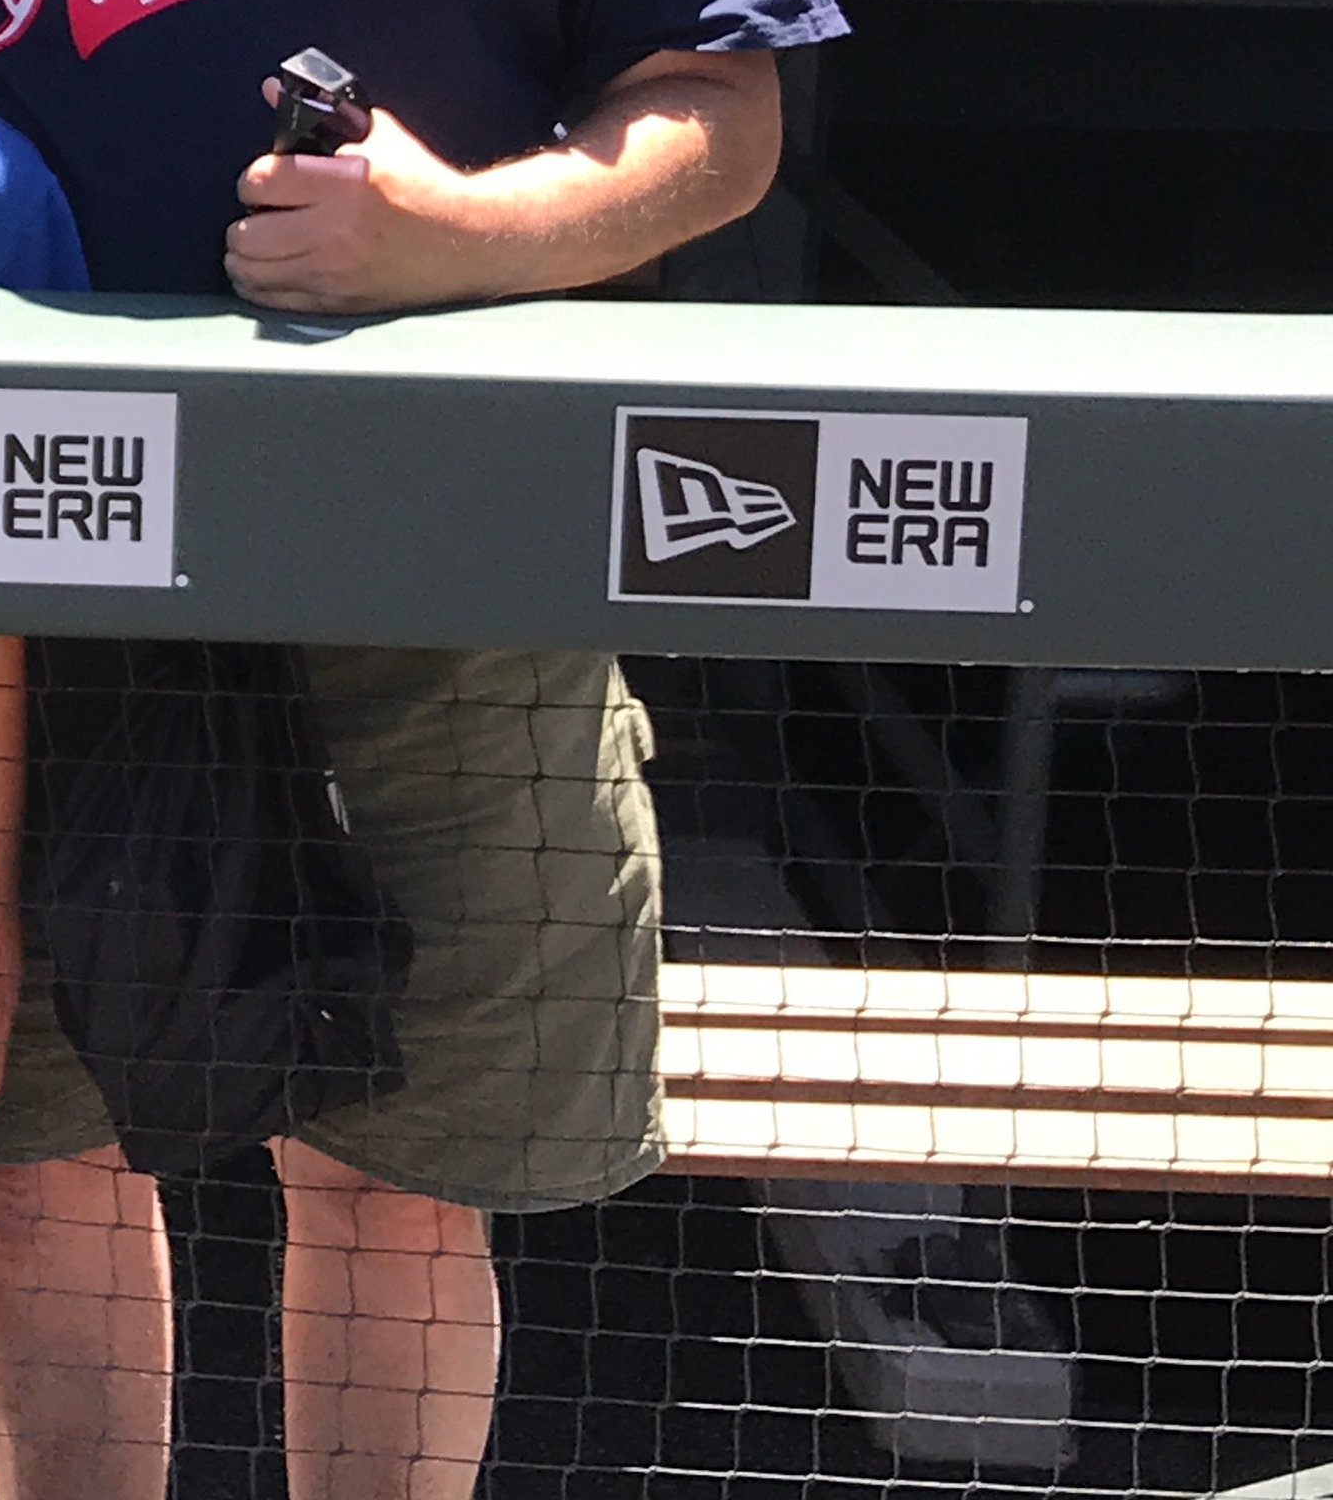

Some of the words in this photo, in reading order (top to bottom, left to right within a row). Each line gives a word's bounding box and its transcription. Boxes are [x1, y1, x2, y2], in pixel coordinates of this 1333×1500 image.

[3, 433, 144, 487] NEW
[848, 457, 993, 512] NEW
[2, 488, 143, 542] ERA
[846, 513, 990, 567] ERA
